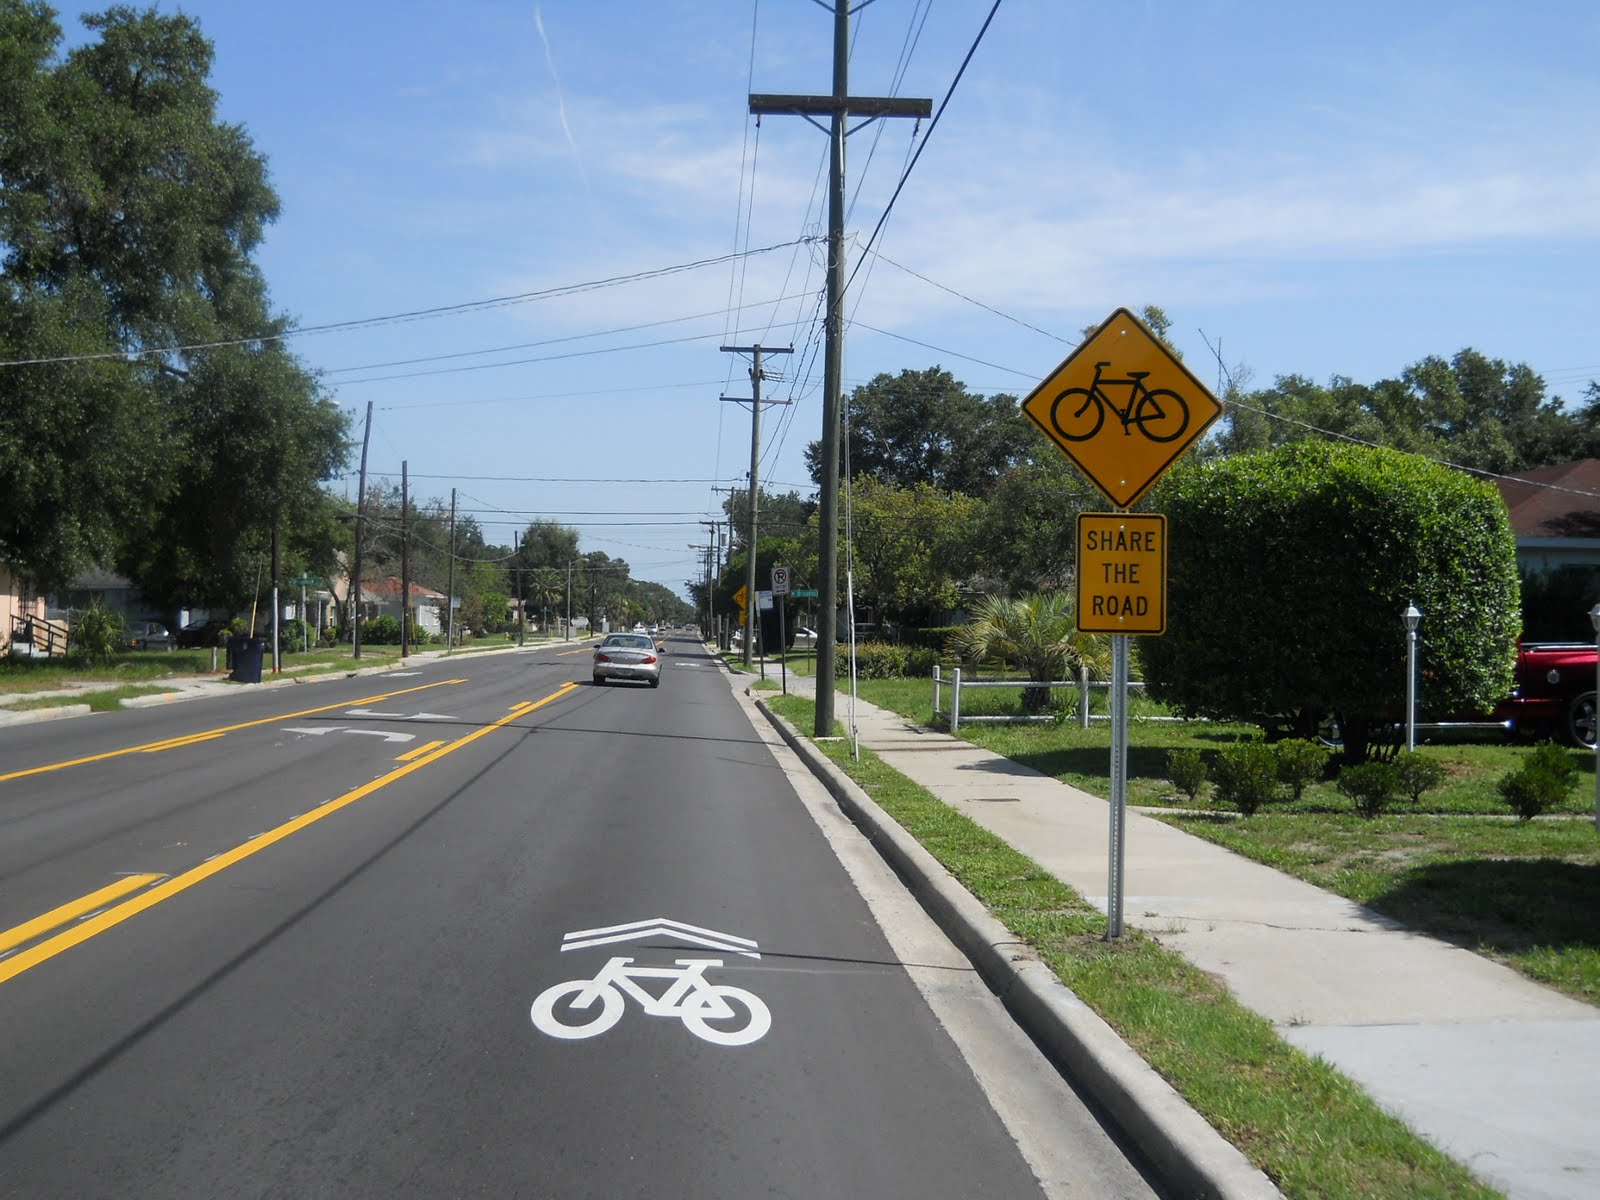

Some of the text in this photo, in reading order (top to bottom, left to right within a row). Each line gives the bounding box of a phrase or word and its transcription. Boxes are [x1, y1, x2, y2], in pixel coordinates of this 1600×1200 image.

[1086, 530, 1156, 552] SHARE
[1102, 563, 1140, 584] THE
[1092, 595, 1148, 616] ROAD
